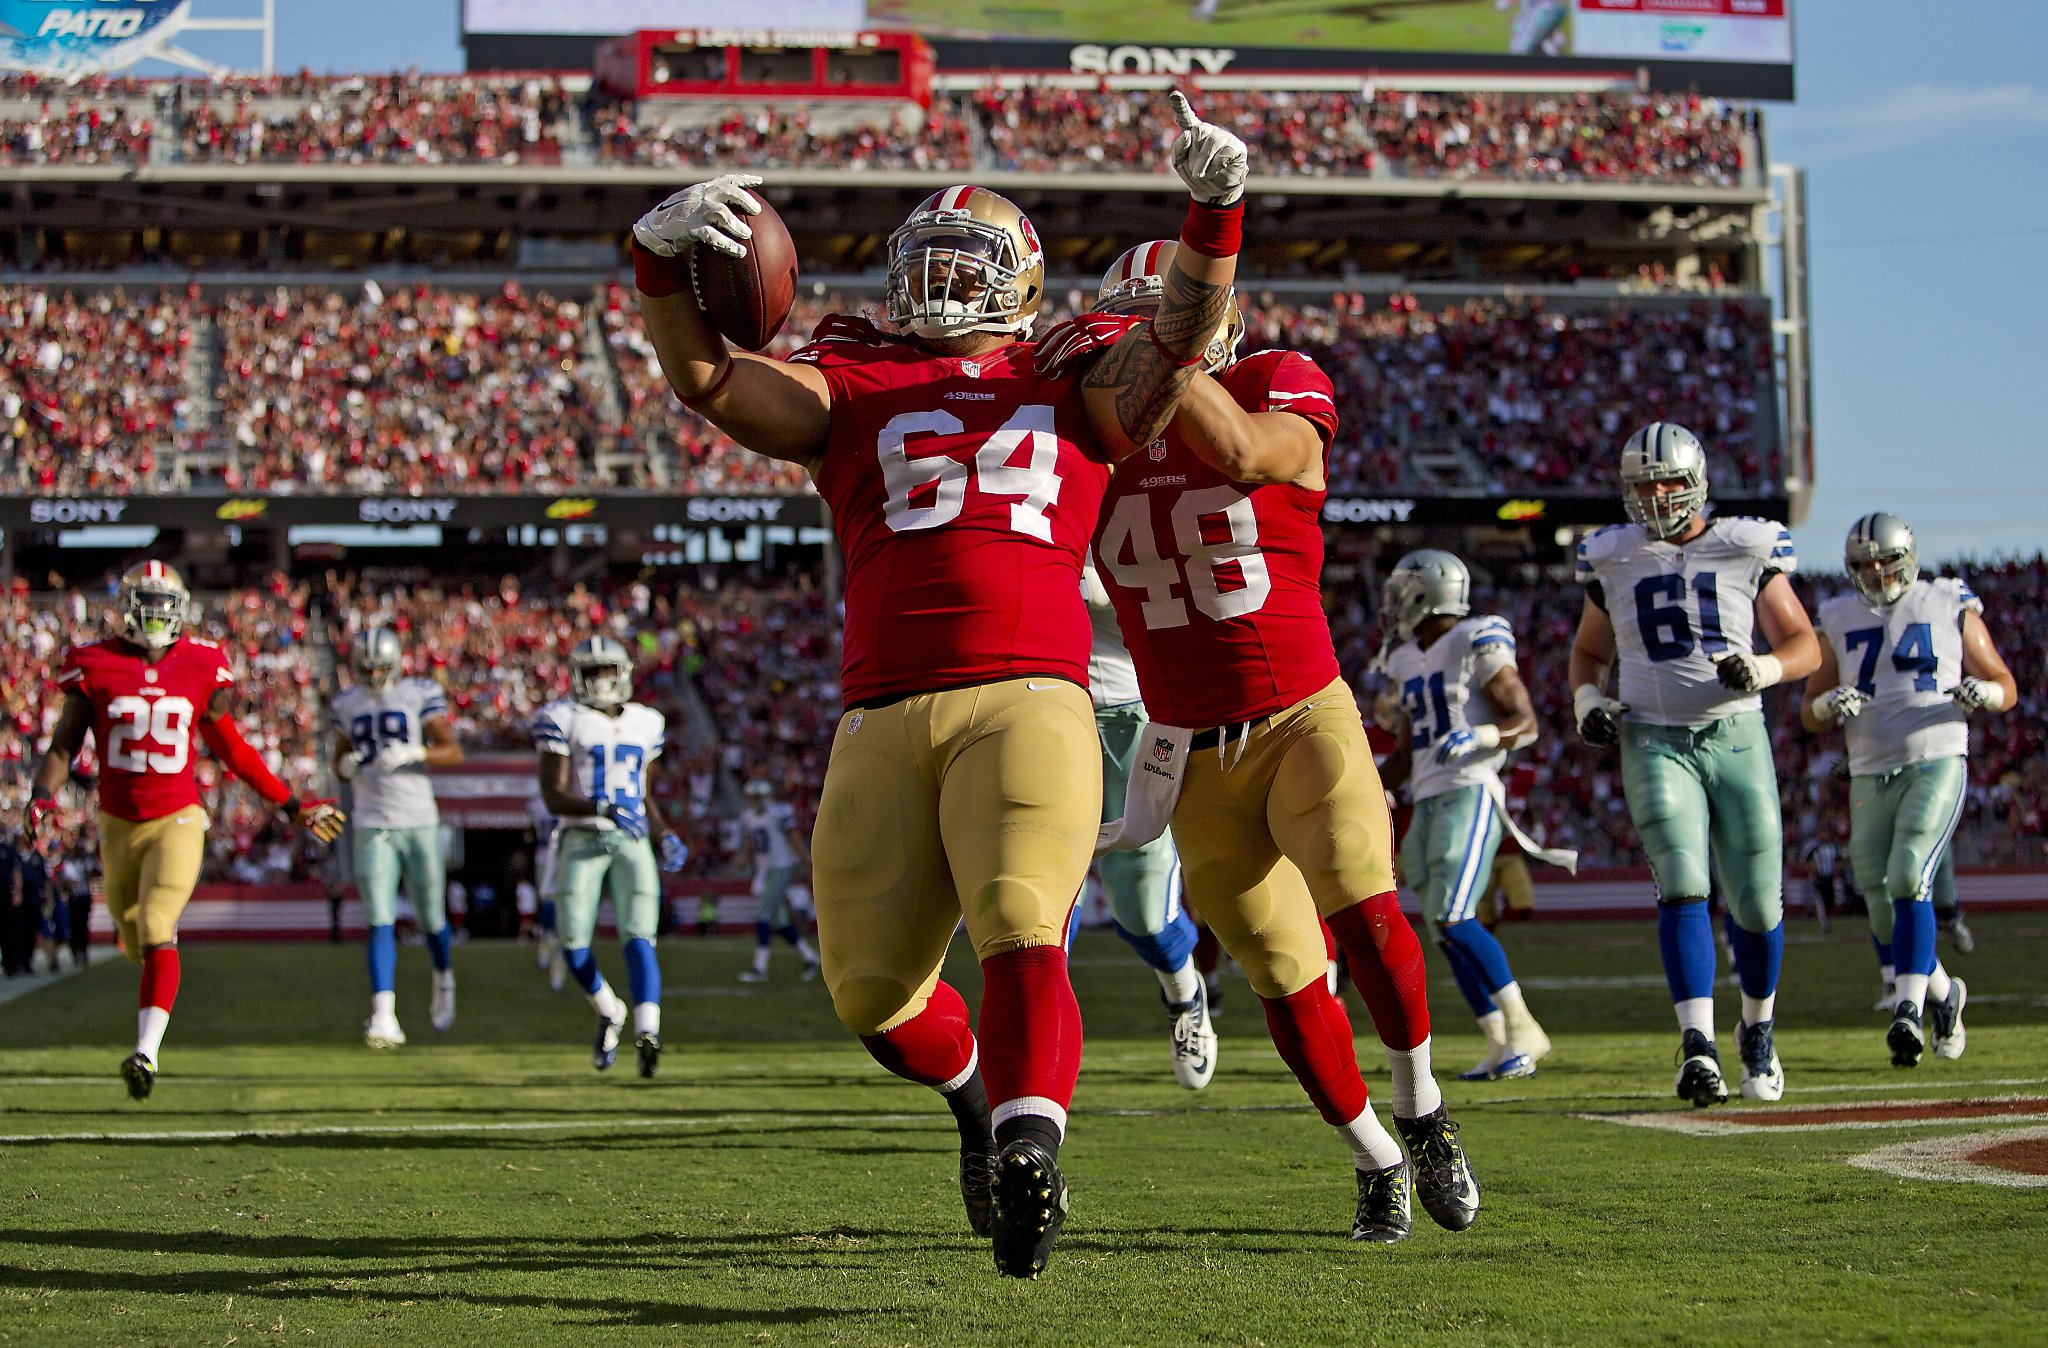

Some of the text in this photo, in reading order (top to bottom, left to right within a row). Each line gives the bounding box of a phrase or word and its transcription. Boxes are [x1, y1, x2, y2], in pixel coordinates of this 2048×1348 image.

[36, 8, 145, 38] PATIO
[1069, 44, 1236, 75] SONY
[944, 391, 995, 400] 49ERS
[878, 405, 1063, 544] 64
[1139, 475, 1187, 488] 49ERS
[30, 499, 128, 523] SONY
[359, 499, 457, 522] SONY
[687, 497, 785, 521] SONY
[1323, 499, 1417, 522] SONY
[1099, 485, 1271, 630] 48
[1634, 572, 1728, 662] 61
[1845, 623, 1938, 698] 74
[1402, 671, 1450, 749] 21
[107, 695, 194, 774] 29
[1154, 748, 1171, 762] NFL
[589, 744, 643, 814] 13
